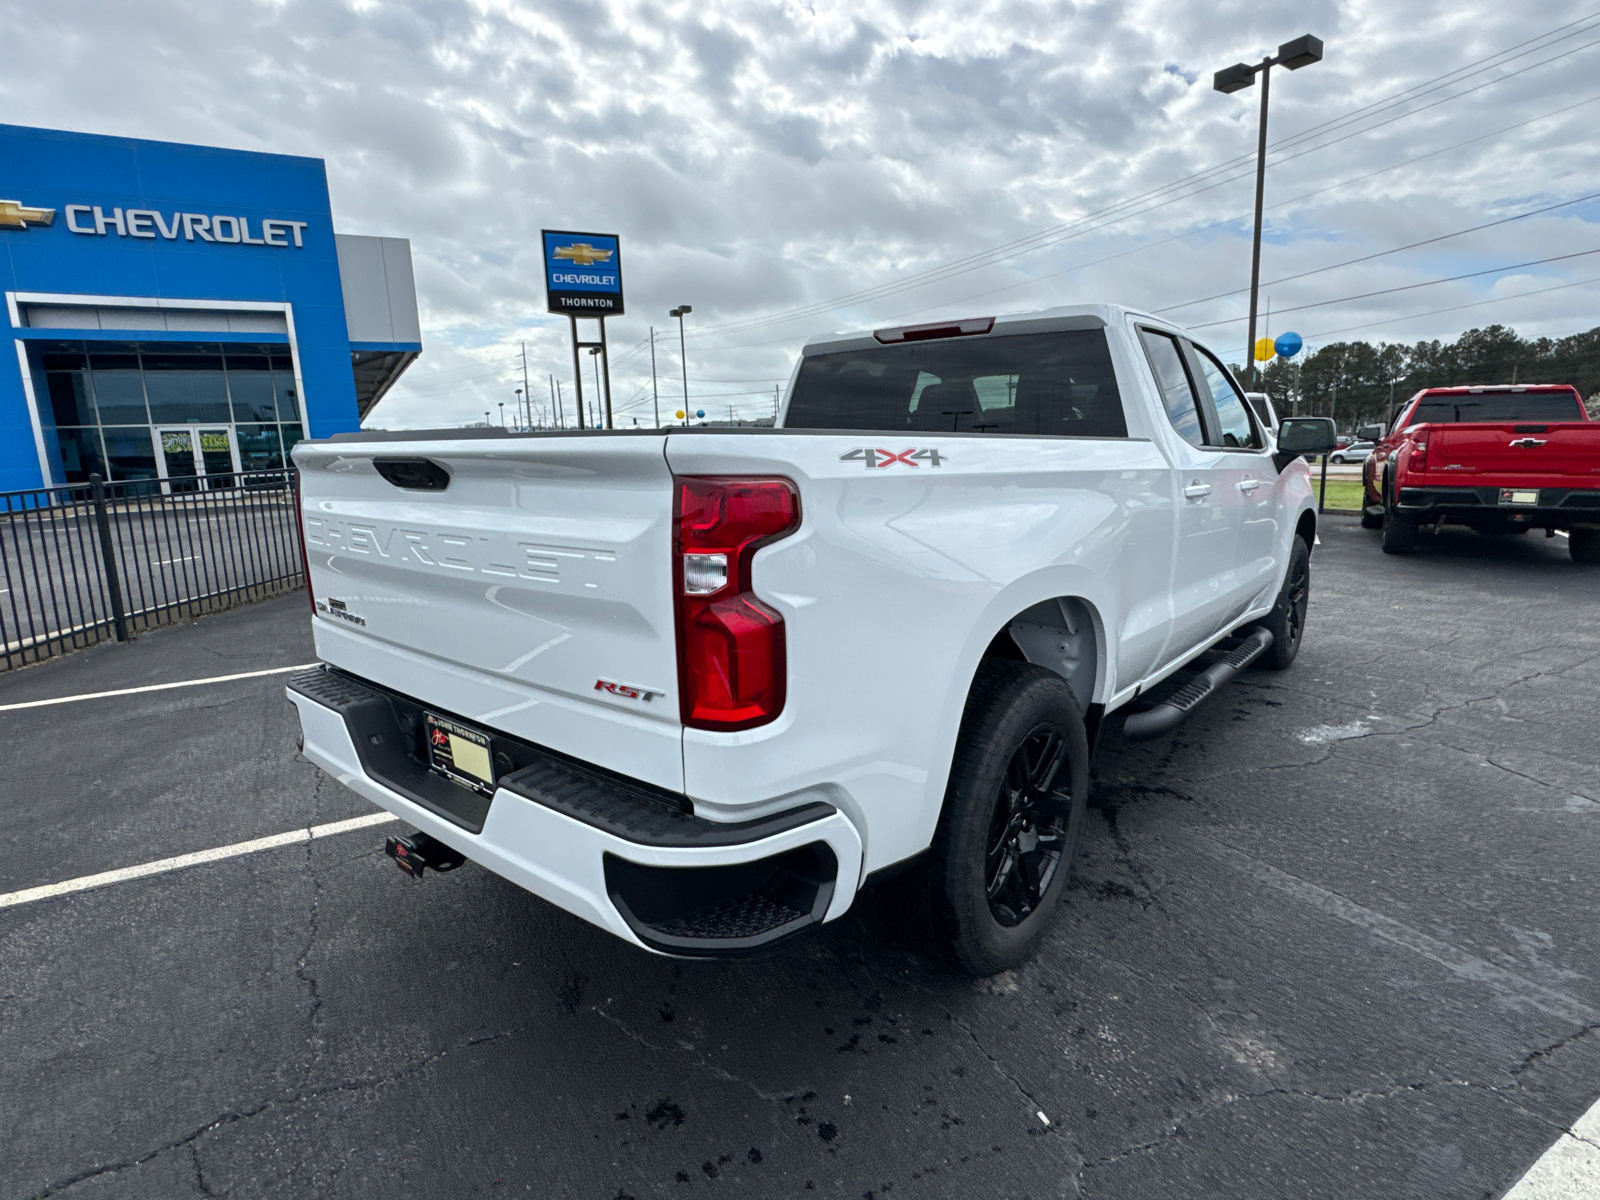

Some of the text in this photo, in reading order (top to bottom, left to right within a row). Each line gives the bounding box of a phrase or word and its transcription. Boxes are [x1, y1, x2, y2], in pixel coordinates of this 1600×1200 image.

[65, 204, 308, 248] CHEVROLET
[552, 273, 616, 285] CHEVROLET
[560, 297, 613, 308] THORNTON
[840, 448, 948, 468] 4X4
[306, 516, 617, 588] CHEVROLET
[594, 677, 665, 702] RST
